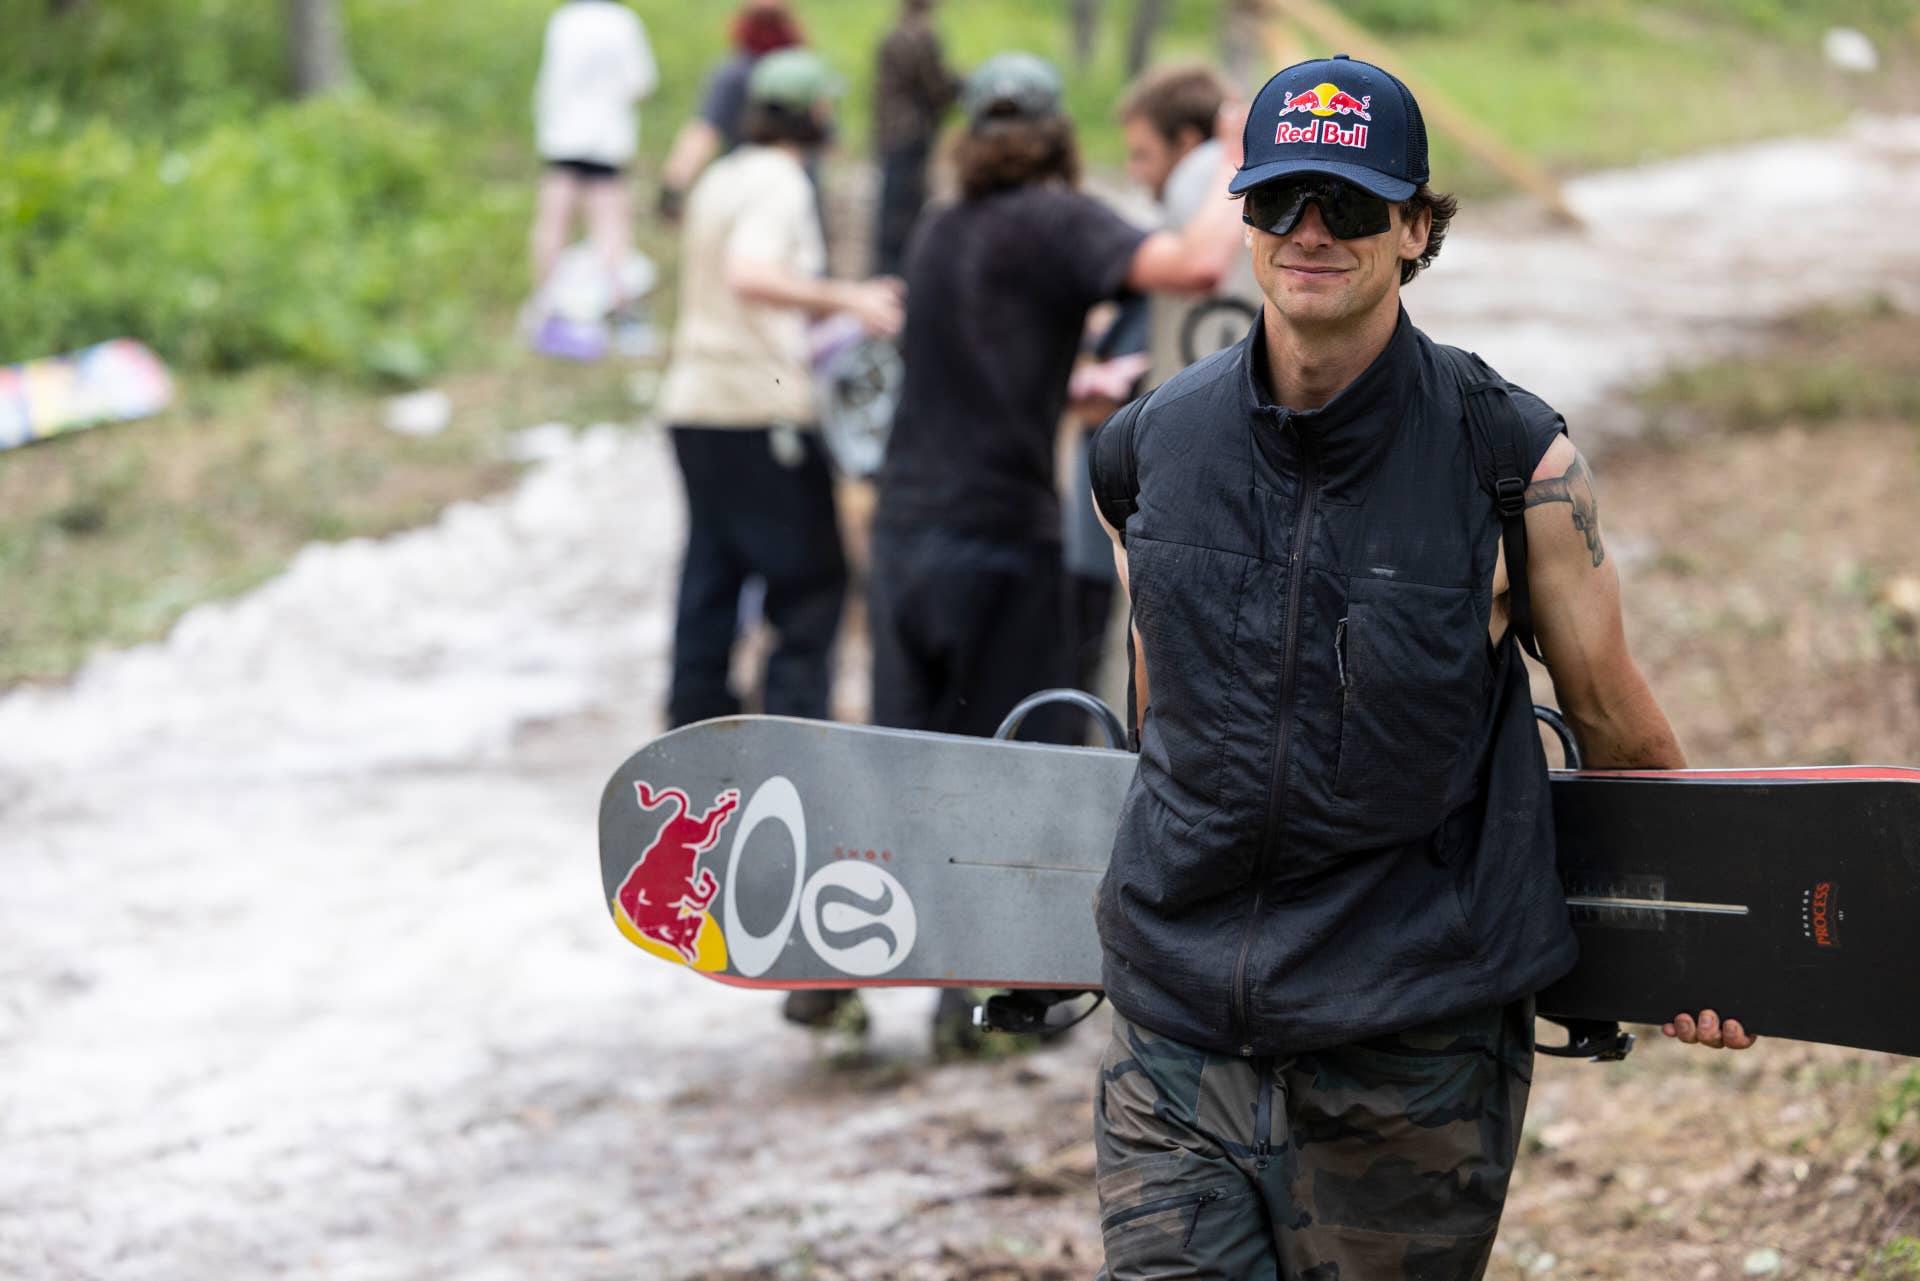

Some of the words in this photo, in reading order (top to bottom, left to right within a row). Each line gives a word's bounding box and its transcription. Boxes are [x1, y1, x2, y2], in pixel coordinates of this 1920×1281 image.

[1275, 119, 1319, 145] Red
[1322, 121, 1368, 149] Bull
[1813, 882, 1831, 944] PROCESS
